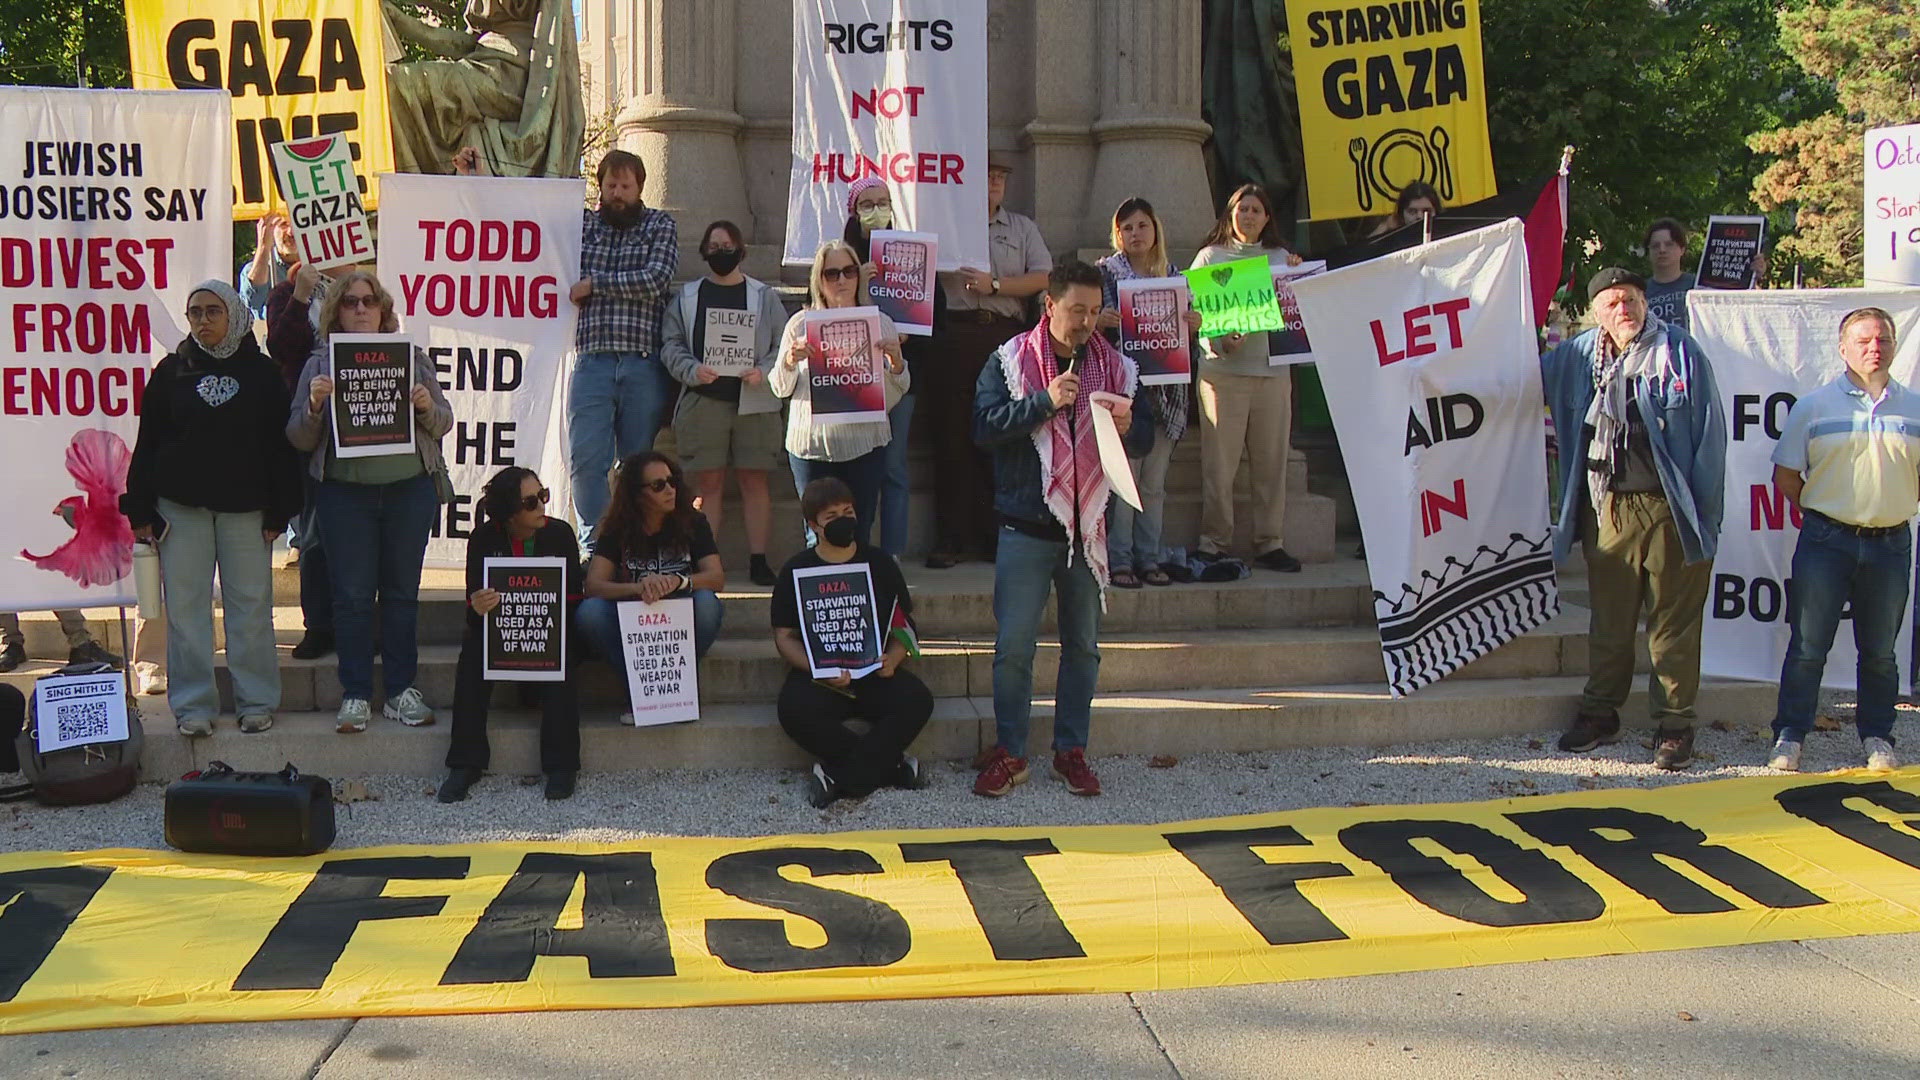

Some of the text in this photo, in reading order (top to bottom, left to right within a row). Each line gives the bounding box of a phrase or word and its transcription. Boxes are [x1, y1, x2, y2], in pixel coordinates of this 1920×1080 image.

[1307, 0, 1466, 48] STARVING
[823, 19, 954, 54] RIGHTS
[166, 18, 366, 97] GAZA
[1322, 43, 1468, 119] GAZA
[851, 86, 925, 119] NOT
[23, 141, 143, 178] JEWISH
[812, 152, 965, 185] HUNGER
[288, 159, 348, 200] LET
[144, 187, 207, 222] SAY
[292, 191, 365, 229] GAZA
[301, 221, 369, 265] LIVE
[418, 218, 541, 262] TODD
[1, 237, 175, 291] DIVEST
[882, 255, 922, 268] DIVEST
[884, 272, 919, 284] FROM
[399, 274, 558, 318] YOUNG
[870, 286, 931, 301] GENOCIDE
[1276, 290, 1294, 300] DIV
[1132, 305, 1172, 317] DIVEST
[1282, 305, 1300, 316] FRO
[709, 311, 756, 328] SILENCE
[13, 302, 151, 354] FROM
[1138, 322, 1172, 334] FROM
[1369, 297, 1470, 367] LET
[820, 339, 863, 352] DIVEST
[1124, 338, 1185, 351] GENOCIDE
[355, 352, 390, 363] GAZA:
[704, 346, 754, 359] VIOLENCE
[826, 355, 865, 368] FROM
[340, 368, 405, 380] STARVATION
[428, 347, 524, 392] END
[349, 380, 397, 391] IS BEING
[811, 372, 881, 387] GENOCIDE
[343, 390, 402, 402] USED AS A
[349, 402, 397, 414] WEAPON
[352, 414, 394, 426] OF WAR
[1733, 391, 1798, 441] FO
[1404, 393, 1484, 457] AID
[440, 421, 517, 466] HE
[1420, 478, 1469, 538] IN
[508, 576, 543, 587] GAZA:
[819, 581, 851, 593] GAZA:
[499, 592, 557, 603] TARVATION
[806, 594, 867, 611] STARVATION
[501, 605, 549, 616] IS BEING
[816, 606, 861, 621] IS BEING
[495, 617, 554, 628] USED AS A
[638, 613, 672, 626] GAZA:
[812, 617, 868, 633] USED AS A
[500, 629, 549, 640] WEAPON
[627, 629, 688, 645] STARVATION
[818, 630, 864, 643] WEAPON
[503, 641, 546, 652] OF WAR
[635, 643, 680, 657] IS BEING
[824, 641, 864, 653] OF WAR
[633, 655, 687, 671] USED AS A
[639, 669, 682, 684] WEAPON
[46, 683, 115, 698] SING WITH US
[643, 682, 681, 697] OF WAR
[232, 837, 1088, 993] FAST
[1160, 806, 1829, 946] FOR
